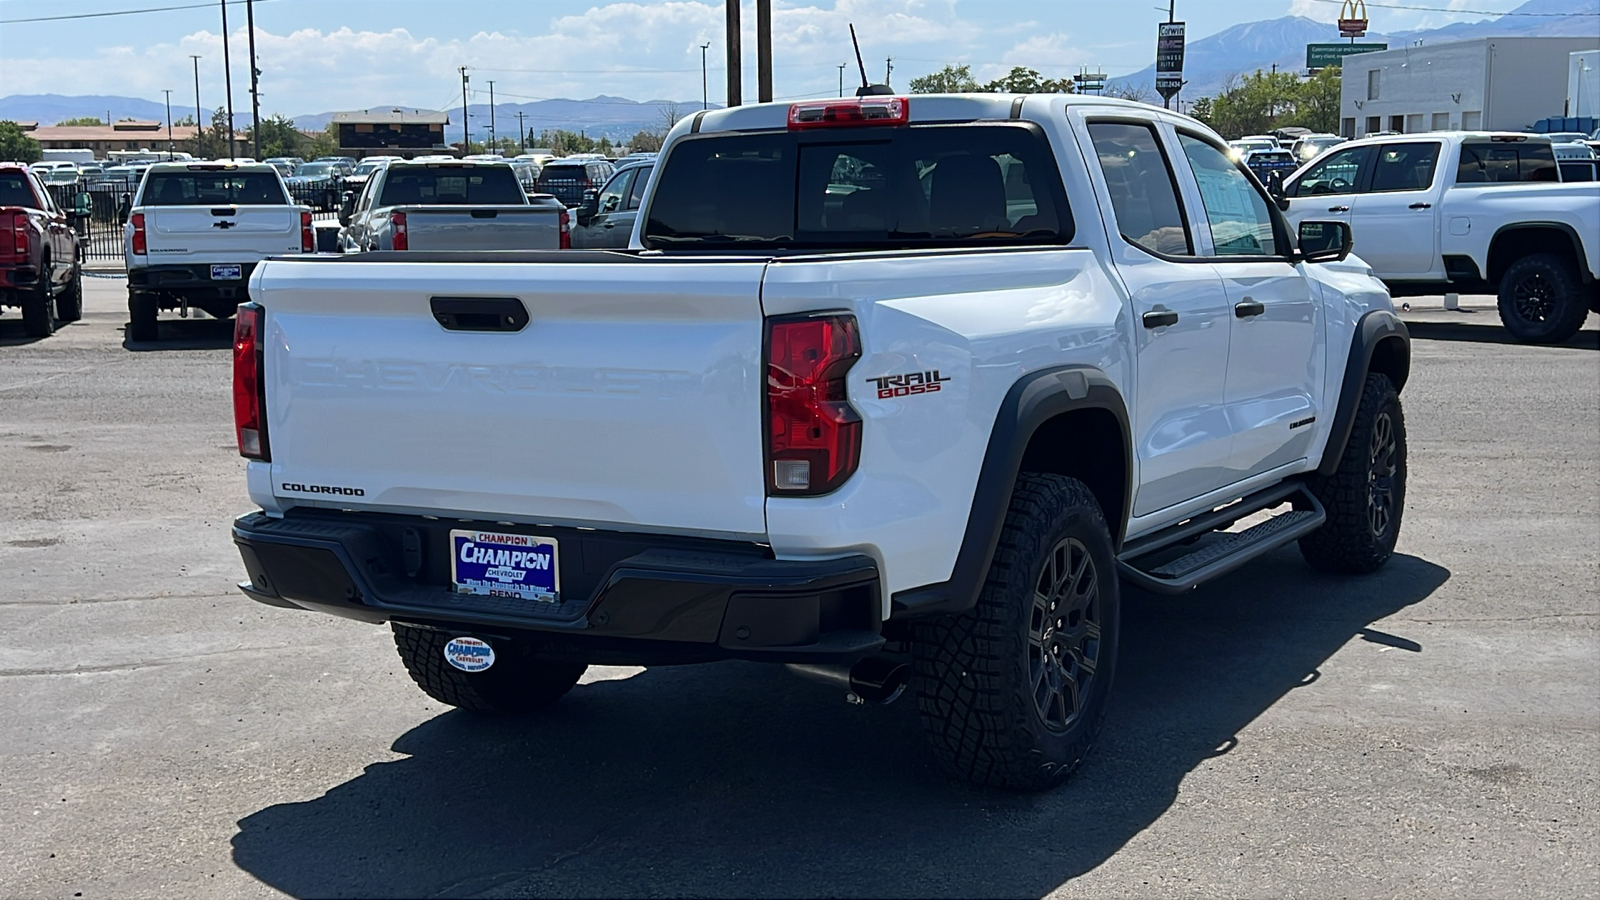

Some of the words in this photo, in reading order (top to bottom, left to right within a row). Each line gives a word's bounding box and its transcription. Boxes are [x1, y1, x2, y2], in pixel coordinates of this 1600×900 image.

[1160, 25, 1184, 36] Corwin
[866, 370, 951, 389] TRAIL
[878, 382, 941, 400] BOSS
[282, 483, 365, 496] COLORADO
[479, 533, 528, 546] CHAMPION
[460, 542, 551, 571] CHAMPION
[487, 569, 524, 579] CHEVROLET
[489, 589, 522, 599] RENO
[447, 643, 491, 657] CHAMPION
[456, 656, 484, 664] CHEVROLET
